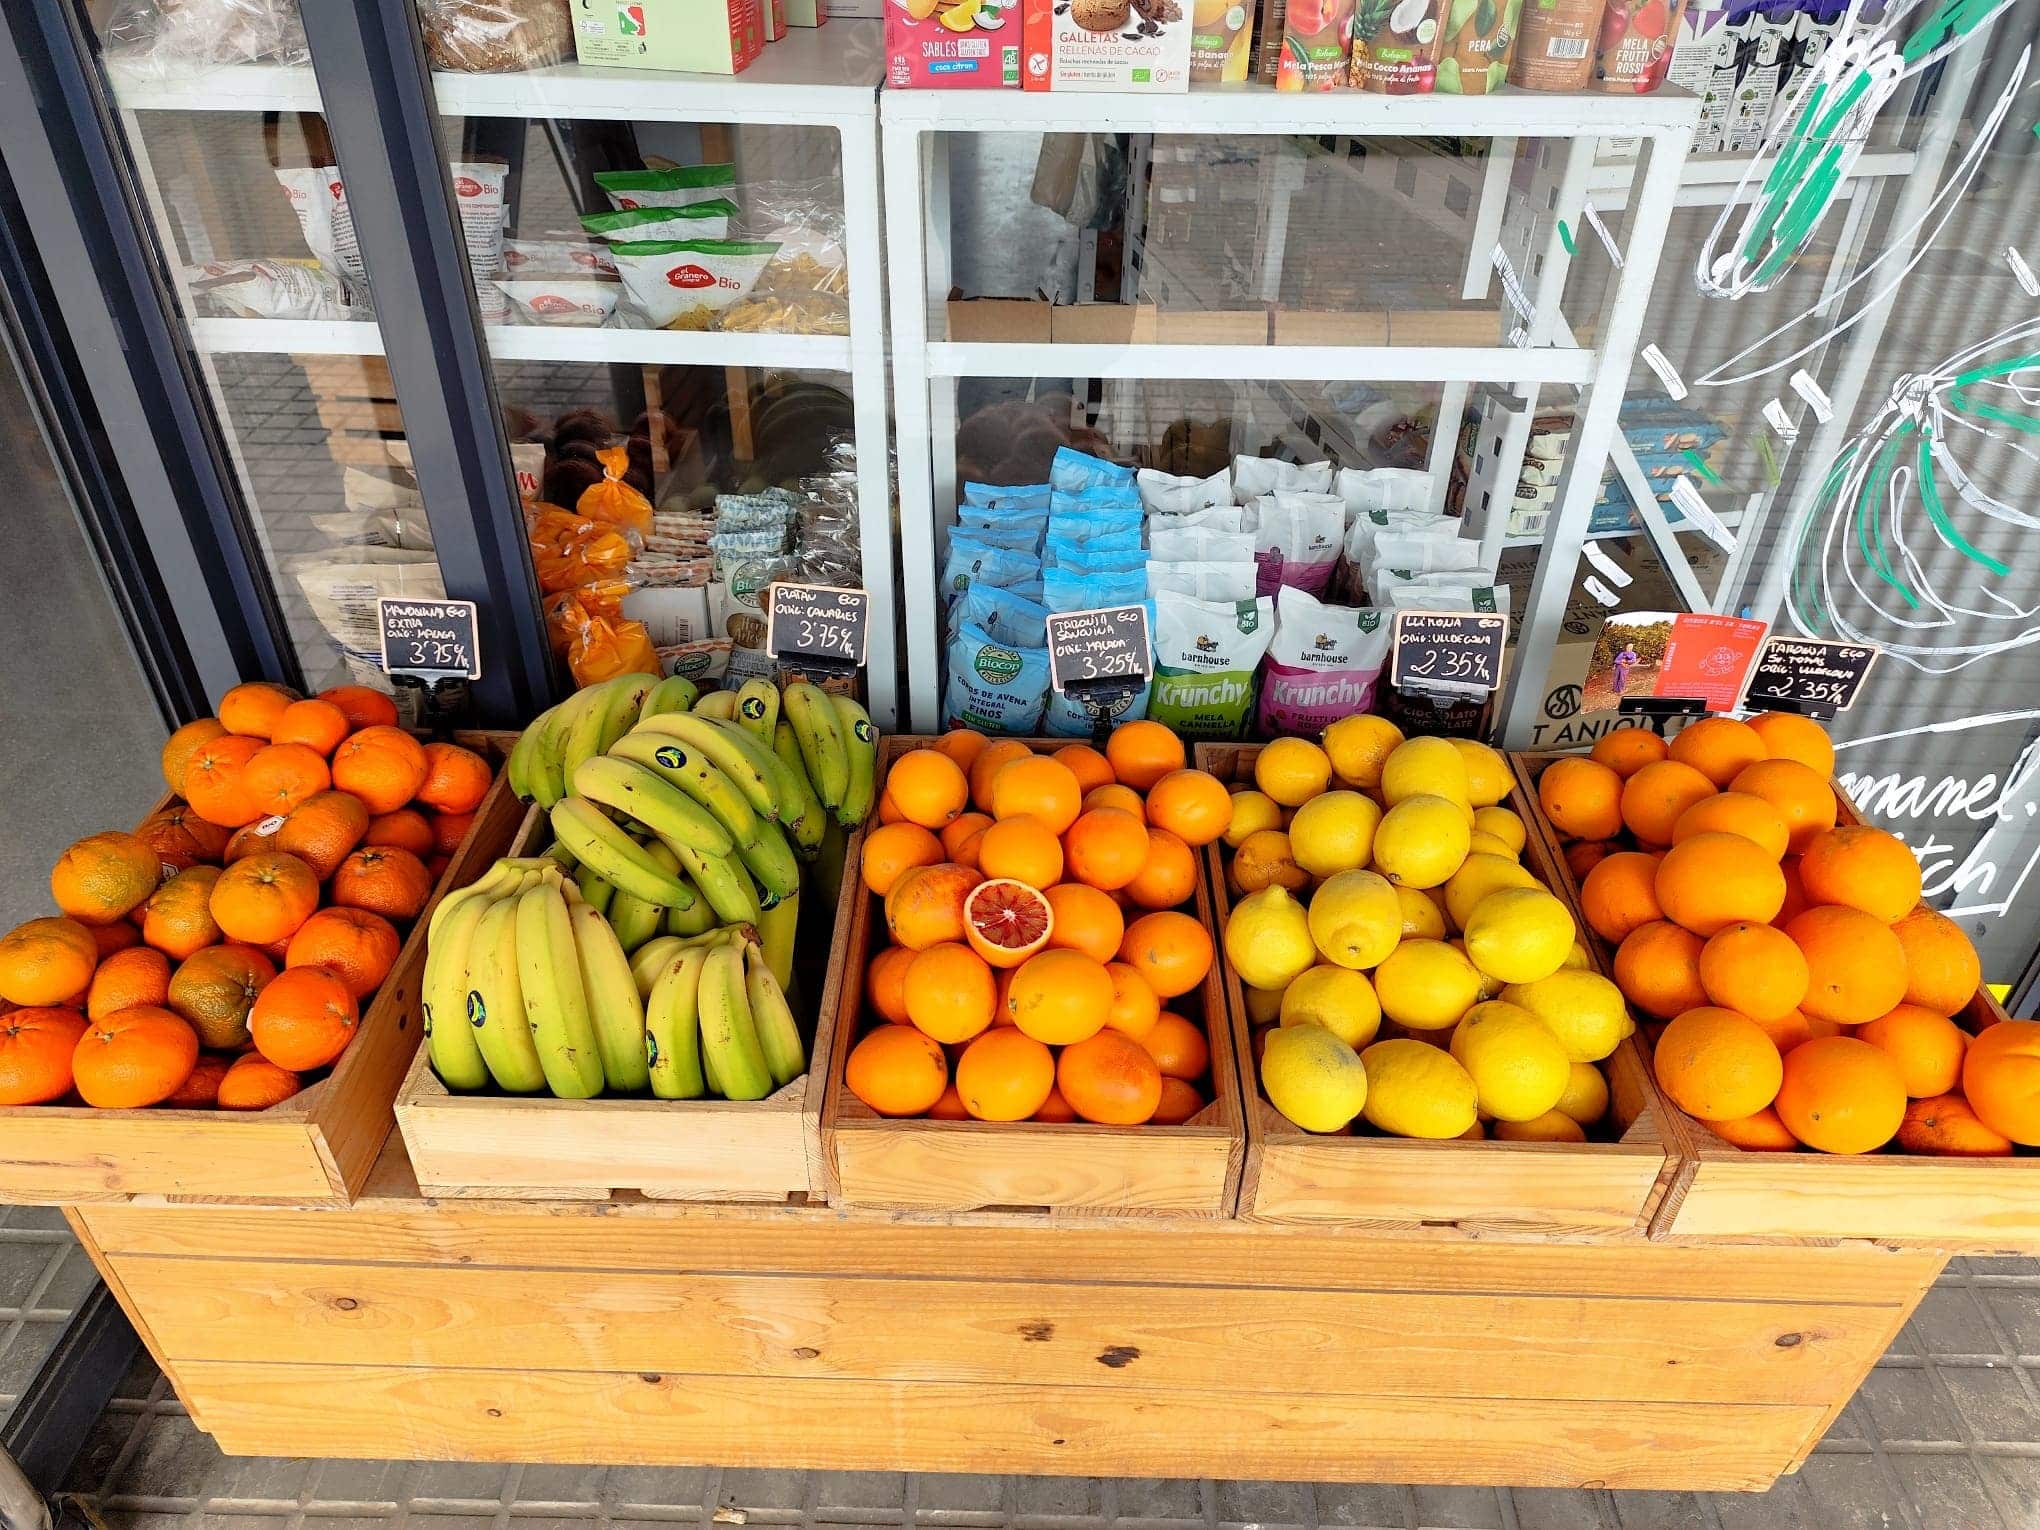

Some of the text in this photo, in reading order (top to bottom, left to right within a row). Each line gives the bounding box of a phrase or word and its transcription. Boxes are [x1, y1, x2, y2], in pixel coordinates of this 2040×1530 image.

[1059, 31, 1119, 44] GALLETAS
[922, 40, 957, 58] SABLÉS
[1468, 39, 1491, 52] PERA
[1622, 38, 1648, 50] MELA
[1059, 45, 1161, 56] RELLENAS DE CACAO
[1615, 50, 1650, 62] FRUTTI
[952, 61, 974, 70] citron
[1283, 60, 1306, 70] Mela
[1308, 62, 1333, 71] Pesca
[1373, 62, 1398, 73] Cocco
[1399, 64, 1432, 73] Ananas
[1615, 62, 1645, 74] ROSSI
[293, 189, 307, 199] Bio
[484, 183, 499, 194] Bio
[674, 272, 741, 290] Granero Bio
[582, 303, 606, 316] Bio
[837, 594, 860, 607] ECO
[446, 606, 467, 618] ECO
[1116, 611, 1139, 622] ECO
[388, 618, 423, 629] EXTRA
[1240, 619, 1255, 629] BIO
[1361, 620, 1377, 628] BIO
[1405, 616, 1502, 629] LLIMONA ECO
[1768, 641, 1867, 659] TARONJA ECO
[979, 657, 1020, 671] Biocop
[1181, 651, 1231, 666] barnhouse
[1300, 651, 1349, 665] barnhouse
[957, 675, 1028, 706] COPOS DE AVENA
[1156, 678, 1249, 708] Krunchy
[1272, 678, 1369, 707] Krunchy
[968, 694, 1006, 710] INTEGRAL
[969, 703, 1003, 719] FINOS
[1194, 713, 1224, 721] MELA
[1179, 720, 1237, 729] CANNELLA
